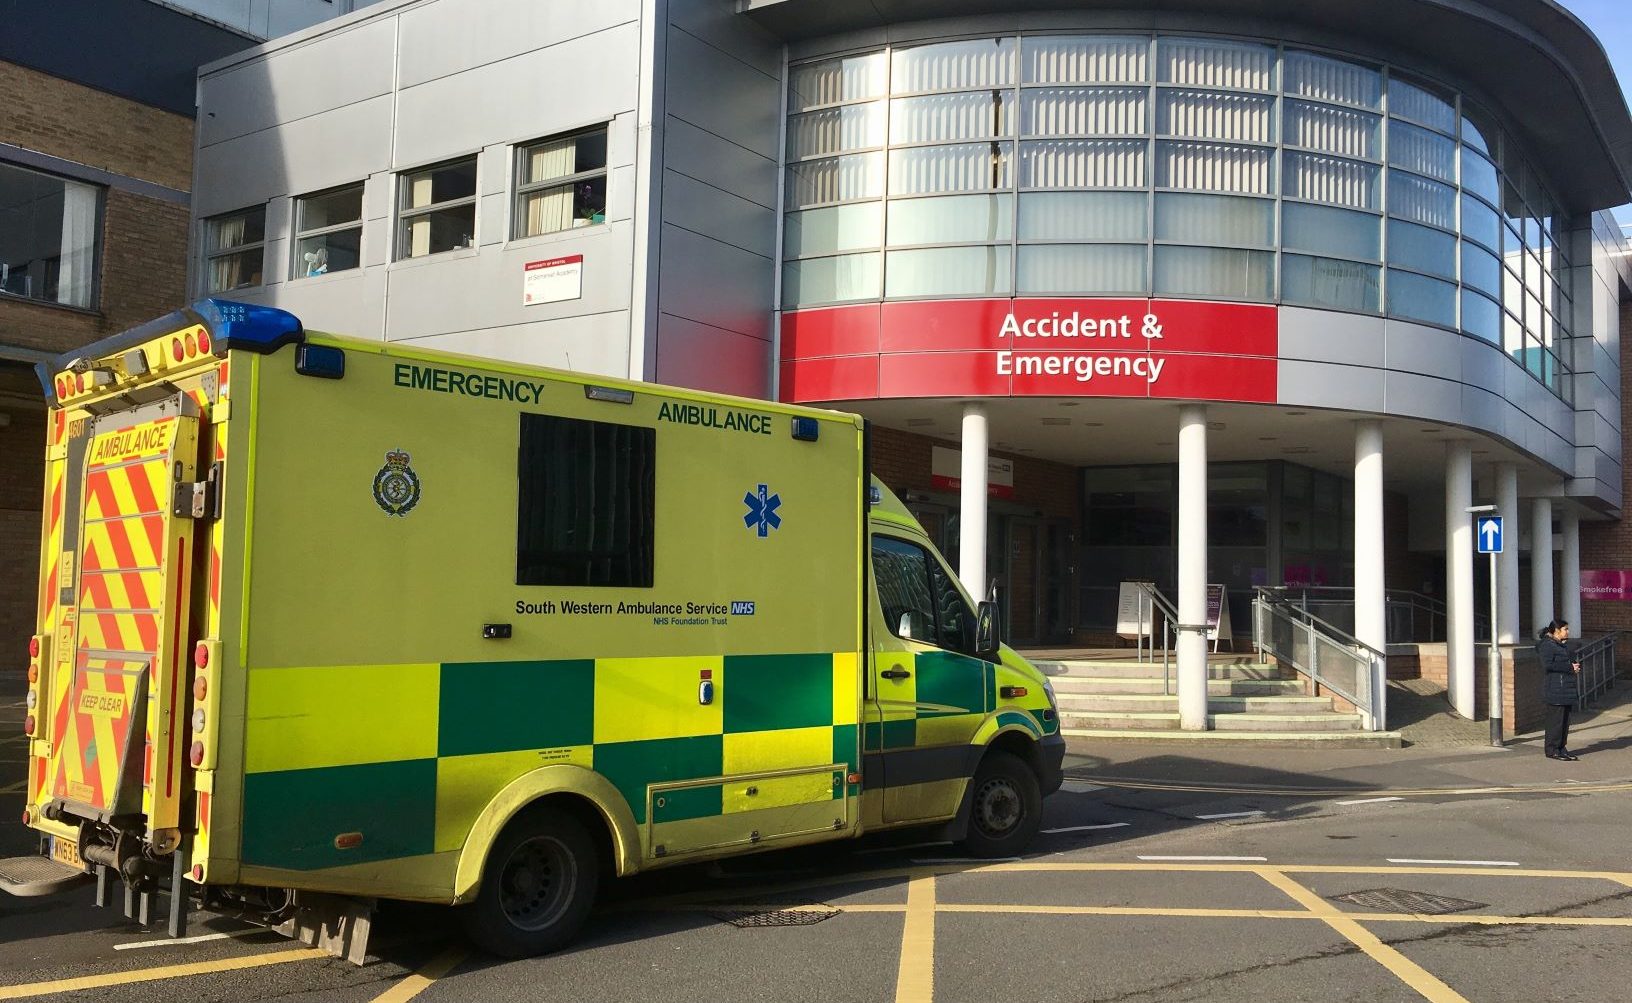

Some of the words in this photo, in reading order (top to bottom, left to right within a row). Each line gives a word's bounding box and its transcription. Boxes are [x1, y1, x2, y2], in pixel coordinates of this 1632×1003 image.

[998, 311, 1131, 339] Accident
[1141, 313, 1164, 339] &
[996, 350, 1166, 383] Emergency
[394, 363, 545, 405] EMERGENCY
[657, 402, 772, 435] AMBULANCE
[94, 424, 168, 461] AMBULANCE
[1579, 585, 1623, 594] Smokefree
[515, 600, 556, 615] South
[559, 601, 613, 615] Western
[616, 601, 683, 616] Ambulance
[685, 601, 728, 616] Service
[731, 601, 755, 615] NHS
[653, 617, 669, 625] NHS
[671, 617, 709, 626] Foundation
[711, 617, 728, 626] Trust
[81, 694, 99, 709] KEEP
[99, 696, 122, 713] CLEAR
